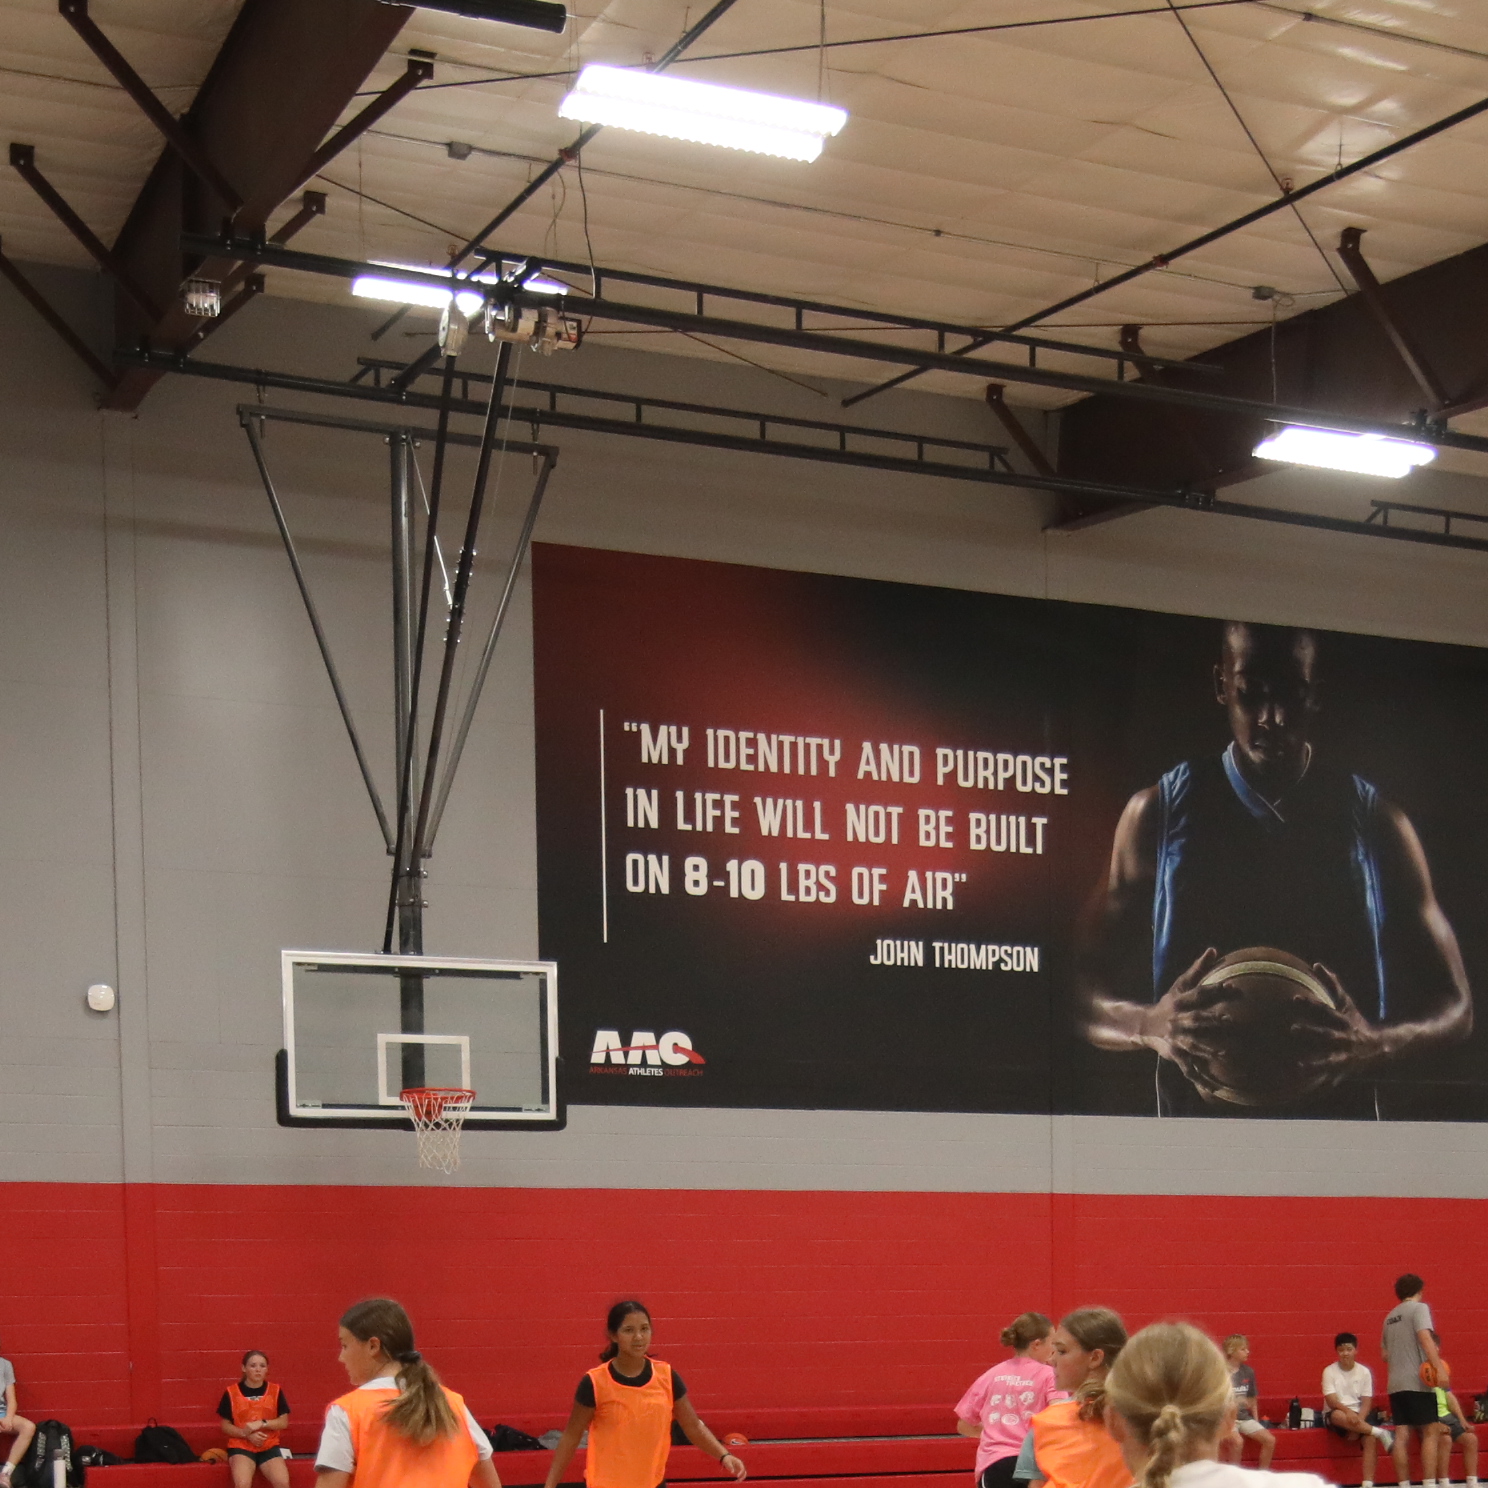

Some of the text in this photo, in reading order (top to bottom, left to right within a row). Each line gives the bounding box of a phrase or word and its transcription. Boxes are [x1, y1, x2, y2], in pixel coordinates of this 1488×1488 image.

[706, 728, 841, 777] IDENTITY
[857, 741, 921, 784] AND
[935, 747, 1068, 795] PURPOSE
[625, 787, 1048, 854] IN LIFE WILL NOT BE BUILT
[625, 853, 670, 895] ON
[684, 856, 765, 900] 8-10
[779, 862, 837, 904] LBS
[851, 867, 887, 906] OF
[869, 939, 1039, 972] JOHN THOMPSON
[589, 1066, 703, 1077] ARKANSAS ATHLETES OUTREACH
